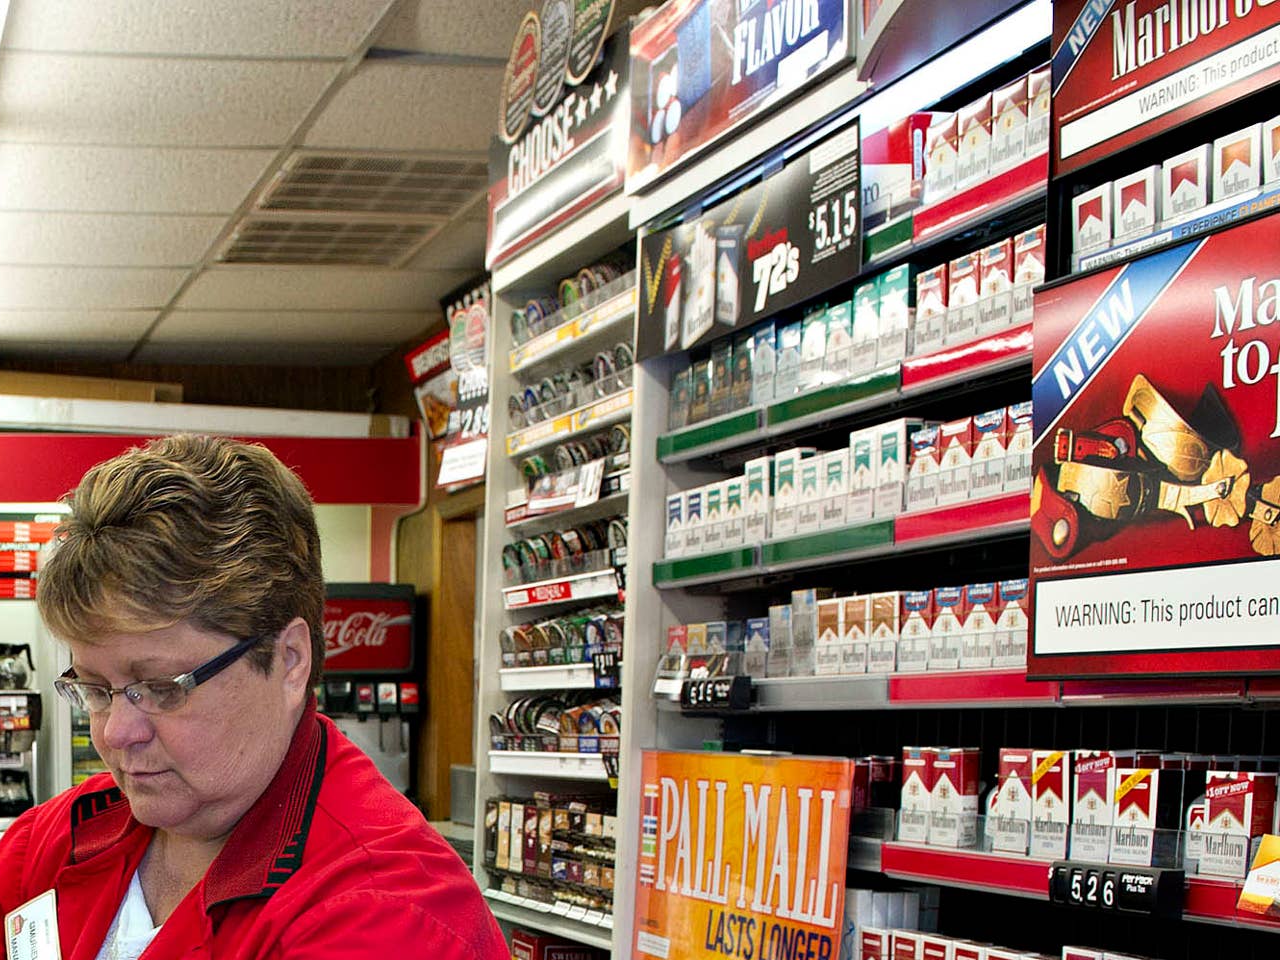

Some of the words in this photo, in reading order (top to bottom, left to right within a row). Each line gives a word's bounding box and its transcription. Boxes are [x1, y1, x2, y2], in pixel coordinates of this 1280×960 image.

[1139, 74, 1200, 114] WARNING:
[1203, 64, 1227, 86] This
[1230, 41, 1278, 77] product
[508, 93, 576, 197] CHOOSE
[1052, 278, 1136, 399] NEW
[1056, 600, 1137, 628] WARNING:
[1141, 597, 1173, 624] This
[1179, 595, 1242, 627] product
[1248, 596, 1279, 617] can
[655, 777, 731, 905] PALL
[736, 784, 838, 929] MALL
[1115, 823, 1149, 848] Marlboro
[1205, 832, 1243, 858] Marlboro
[705, 909, 757, 960] LASTS
